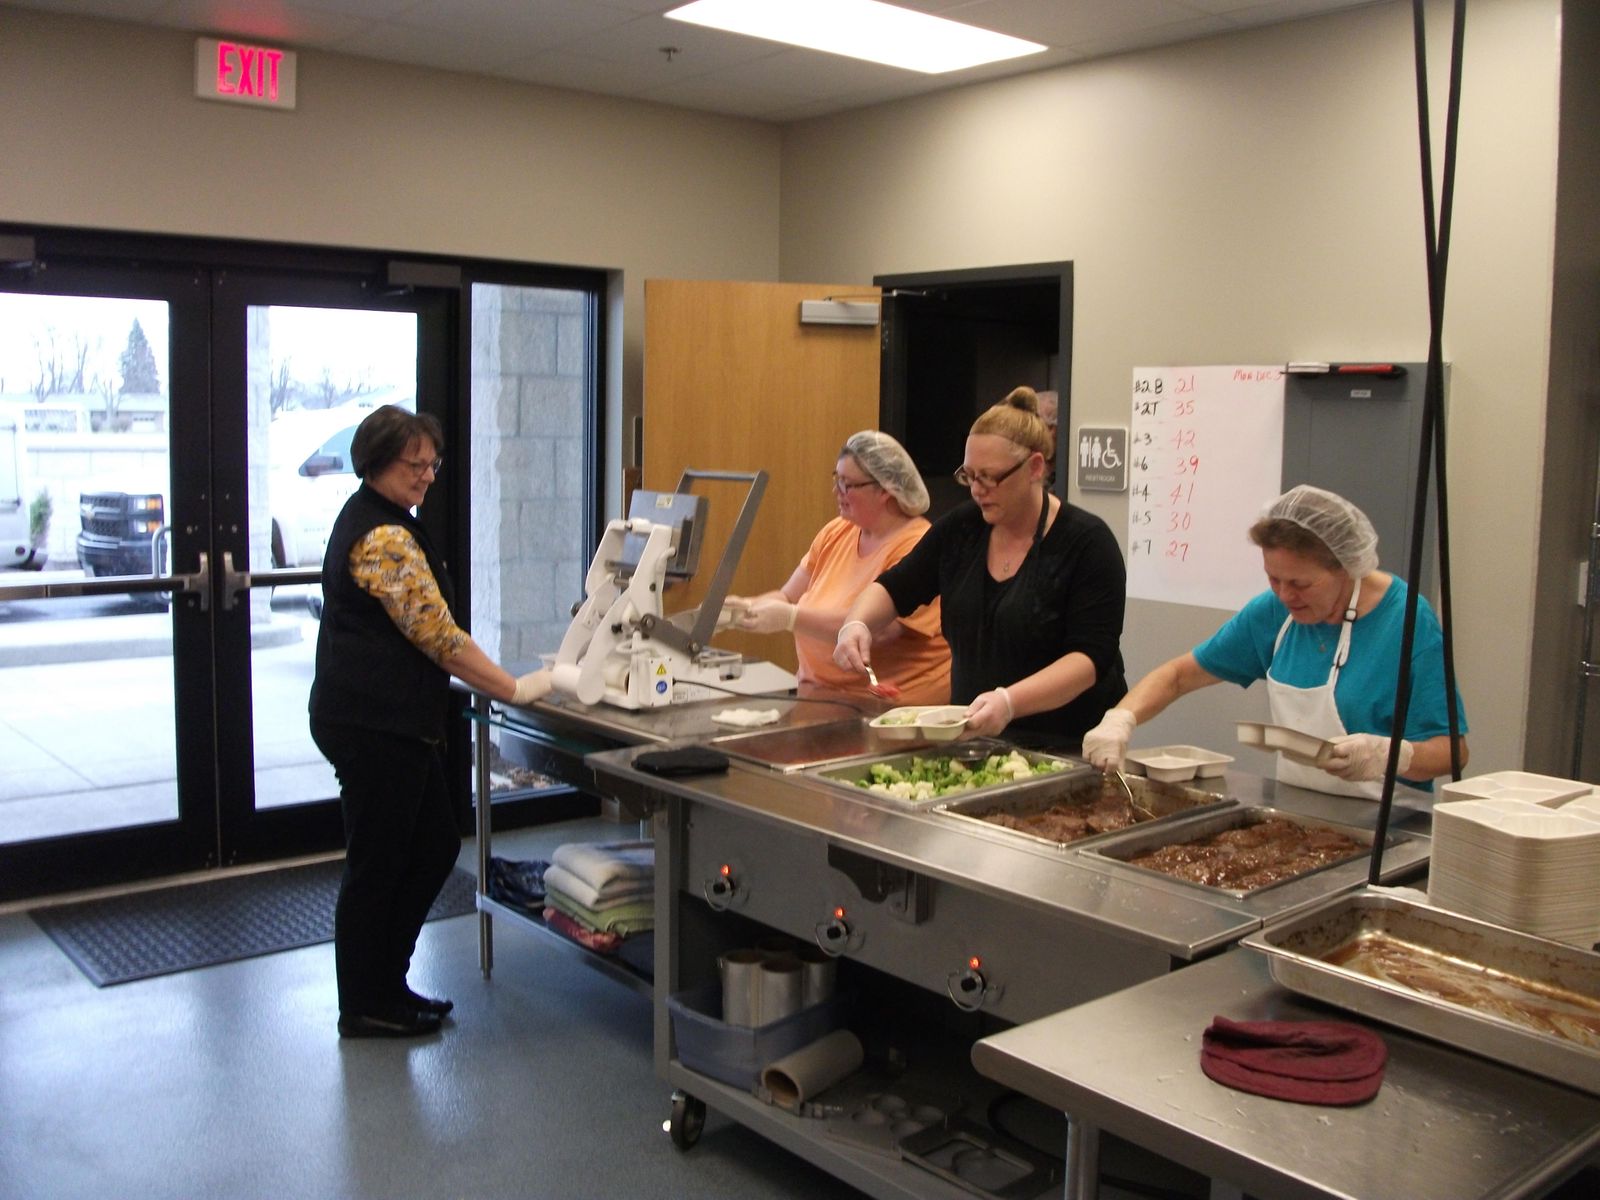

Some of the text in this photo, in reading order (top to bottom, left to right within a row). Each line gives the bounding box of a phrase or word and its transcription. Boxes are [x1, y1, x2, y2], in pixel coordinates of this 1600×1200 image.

[217, 41, 284, 101] EXIT
[1174, 375, 1195, 393] 21
[1174, 400, 1195, 417] 35
[1174, 455, 1200, 475] 39
[1170, 482, 1194, 505] 41
[1167, 511, 1191, 532] 30
[1166, 540, 1189, 562] 27
